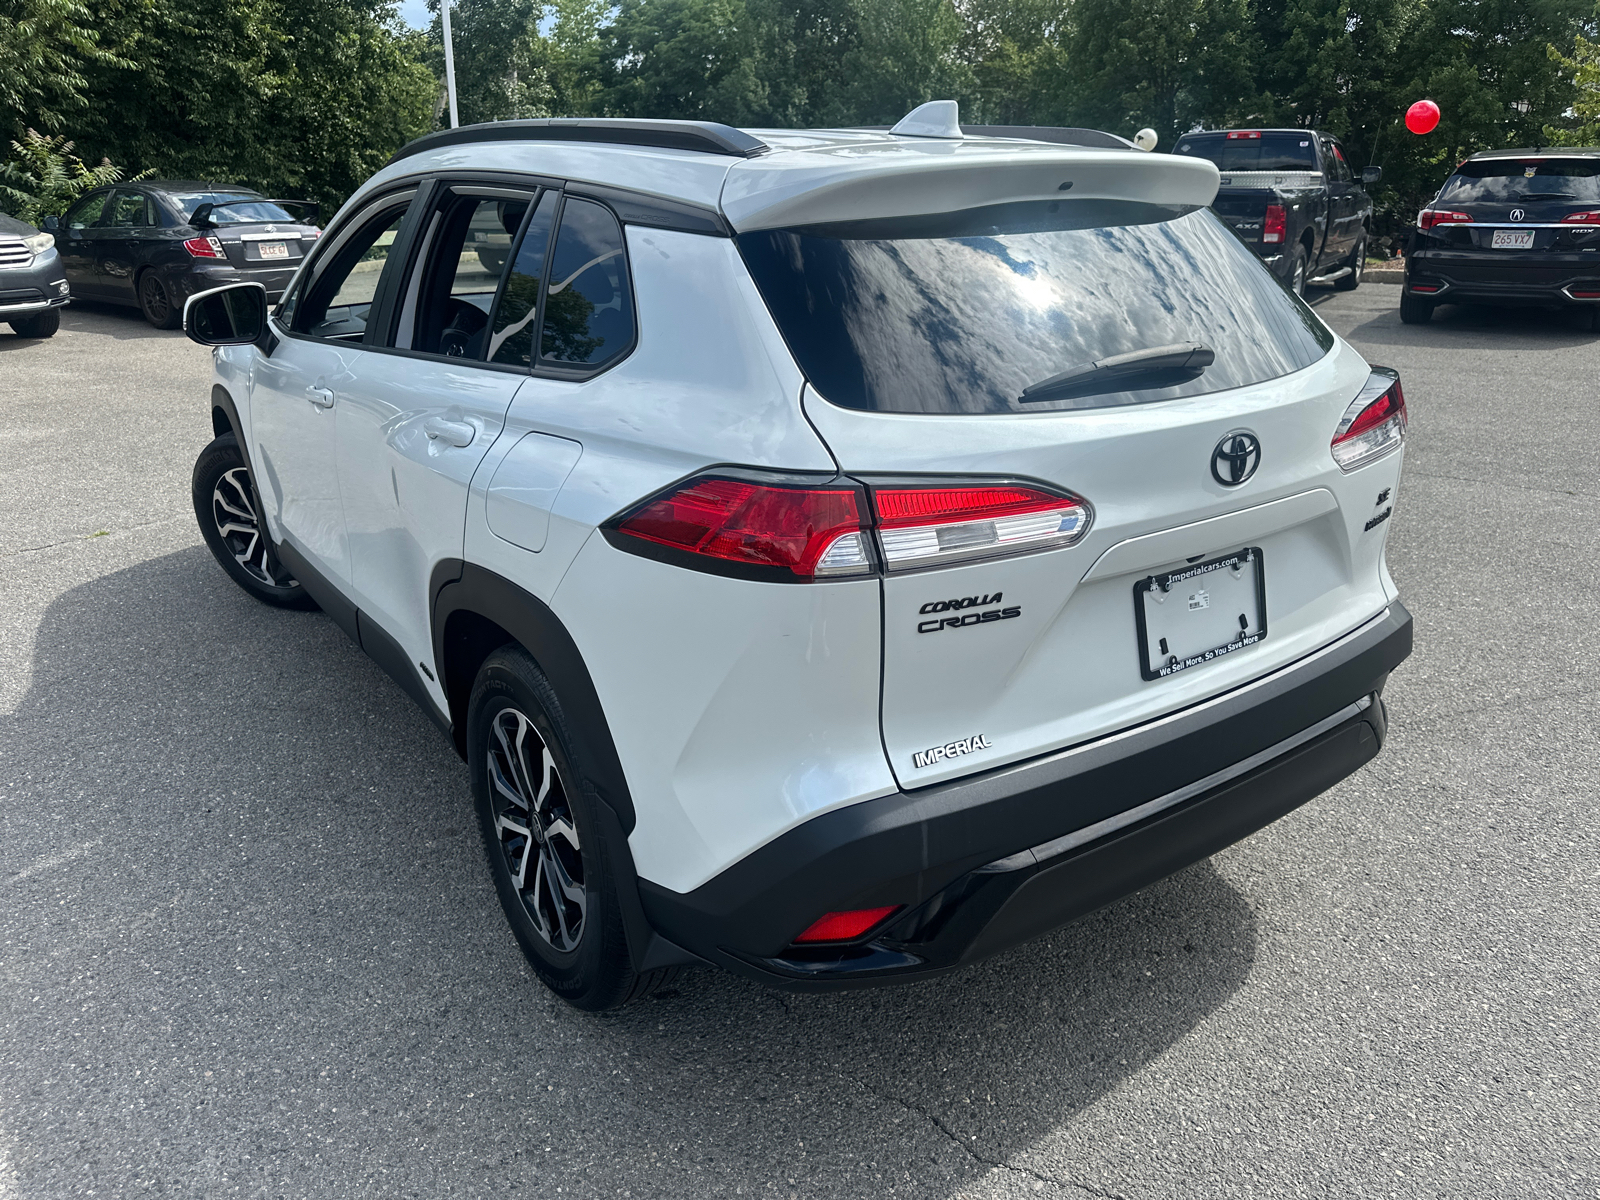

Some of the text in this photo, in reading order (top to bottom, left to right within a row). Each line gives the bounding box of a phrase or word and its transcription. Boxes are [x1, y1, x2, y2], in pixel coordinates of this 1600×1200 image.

[278, 245, 286, 254] 67
[1494, 234, 1532, 245] 265 VX7
[1168, 557, 1238, 583] Imperialcars.com
[919, 592, 1003, 614] COROLLA
[918, 605, 1021, 633] CROSS
[1160, 635, 1259, 677] We Sell More, So You Save More
[913, 734, 993, 768] IMPERIAL
